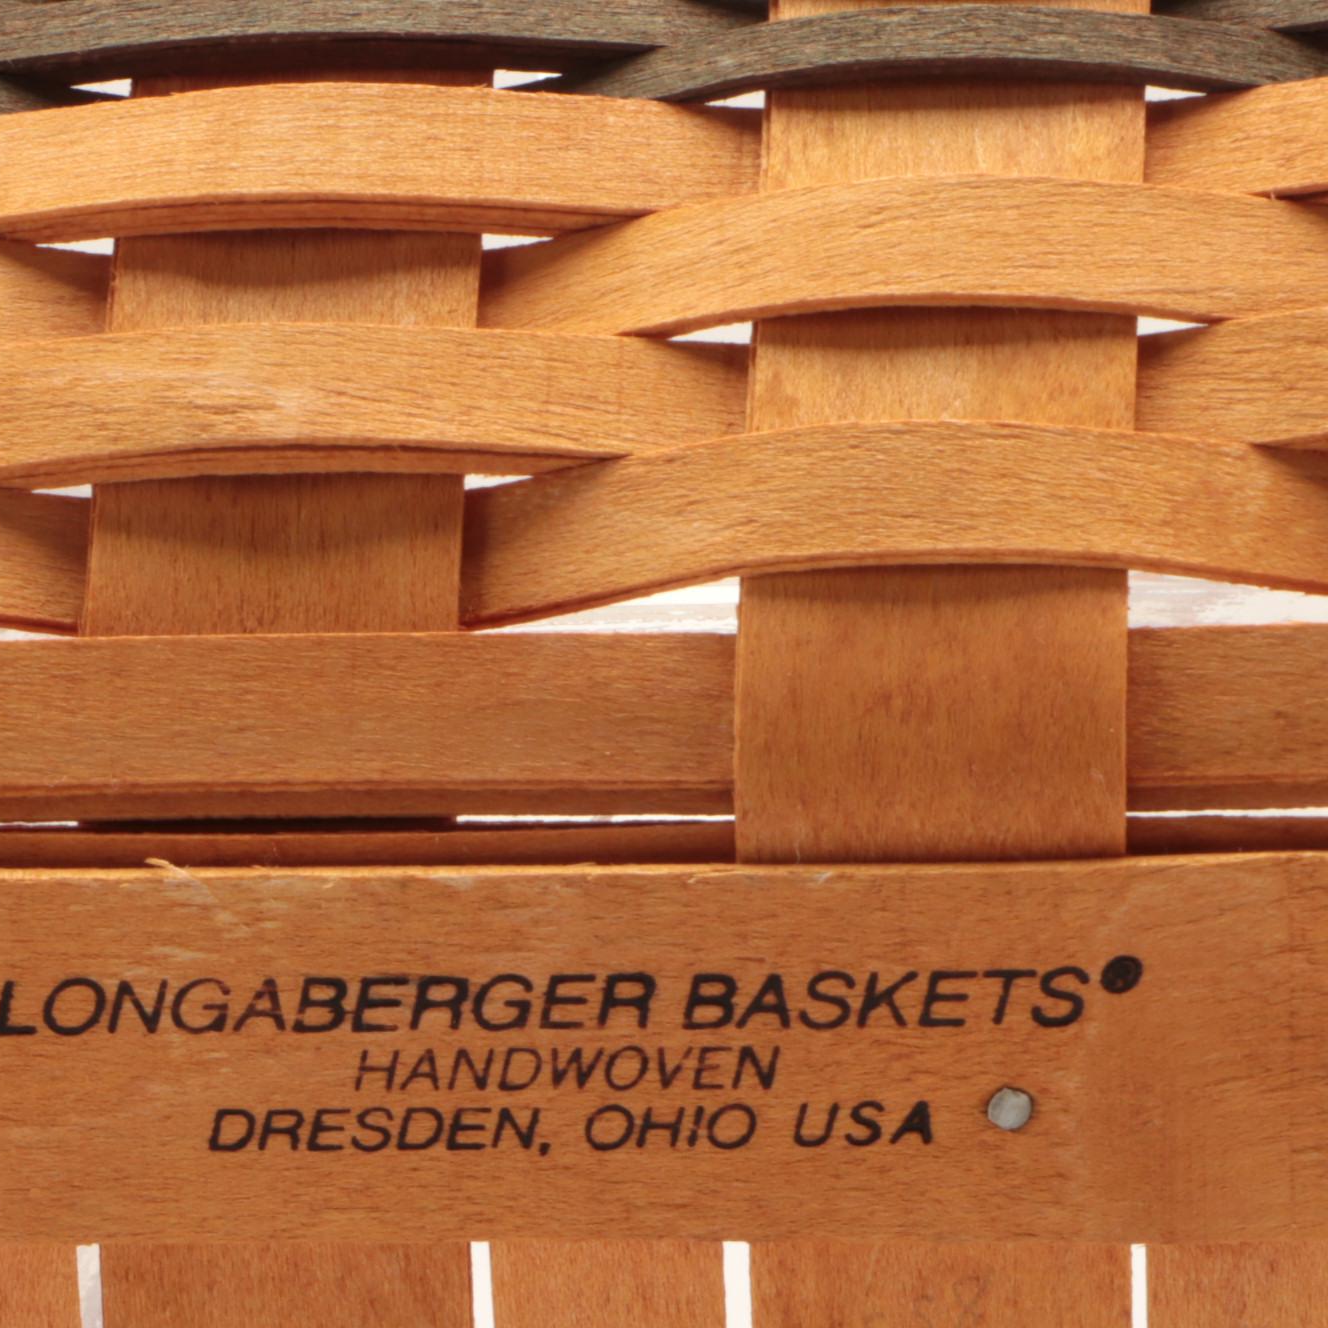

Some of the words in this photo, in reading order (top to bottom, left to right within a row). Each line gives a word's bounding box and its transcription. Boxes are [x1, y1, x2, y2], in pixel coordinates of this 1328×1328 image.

[354, 1044, 780, 1092] HANDWOVEN
[208, 1105, 551, 1156] DRESDEN,
[585, 1103, 757, 1151] OHIO
[793, 1100, 934, 1147] USA
